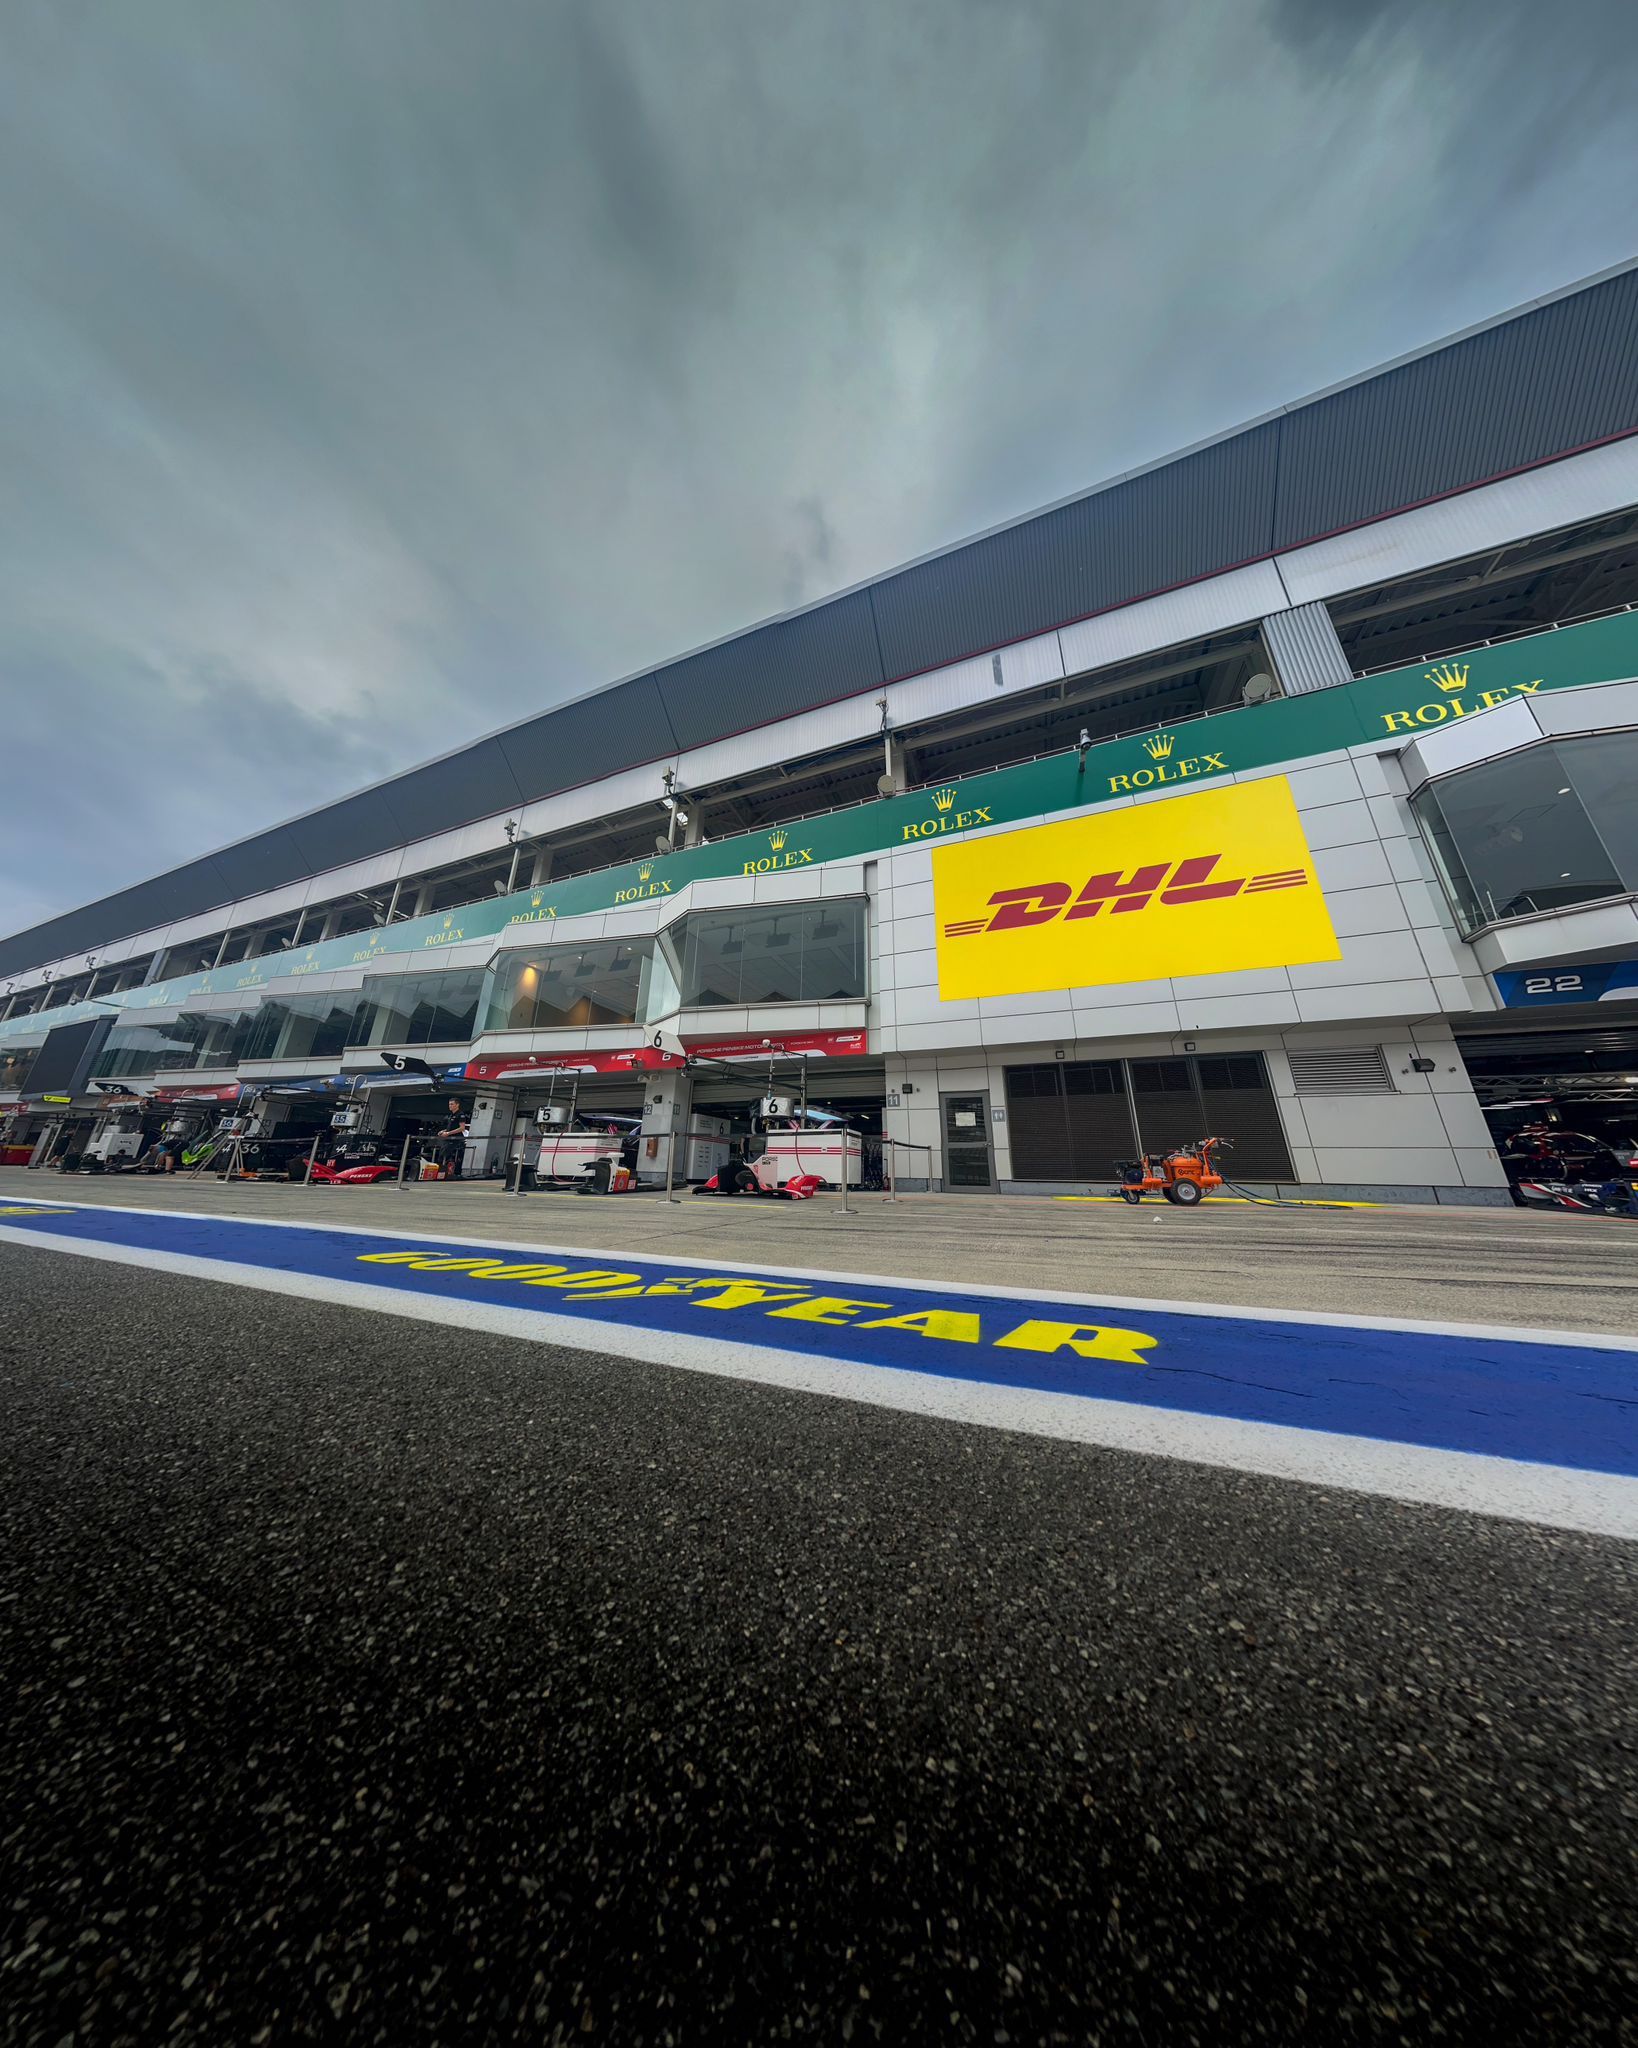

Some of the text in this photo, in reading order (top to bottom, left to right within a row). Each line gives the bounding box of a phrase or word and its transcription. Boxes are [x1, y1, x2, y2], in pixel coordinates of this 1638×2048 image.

[1380, 679, 1544, 733] ROLEX
[1108, 751, 1229, 794] ROLEX
[902, 806, 993, 841] ROLEX
[743, 847, 813, 877] ROLEX
[614, 879, 672, 903] ROLEX
[985, 853, 1246, 932] DHL
[511, 905, 557, 923] ROLEX
[425, 928, 464, 946] ROLEX
[353, 946, 386, 962] ROLEX
[1525, 975, 1583, 994] 22
[654, 1031, 662, 1047] 6
[394, 1055, 406, 1070] 5
[662, 1053, 672, 1061] 6
[479, 1066, 488, 1075] 5
[105, 1085, 122, 1094] 36
[768, 1098, 778, 1114] 6
[888, 1095, 899, 1106] 11
[335, 1115, 346, 1123] 35
[542, 1108, 551, 1121] 5
[719, 1122, 724, 1134] 6
[242, 1143, 260, 1154] 36
[356, 1251, 1159, 1366] GOODYEAR
